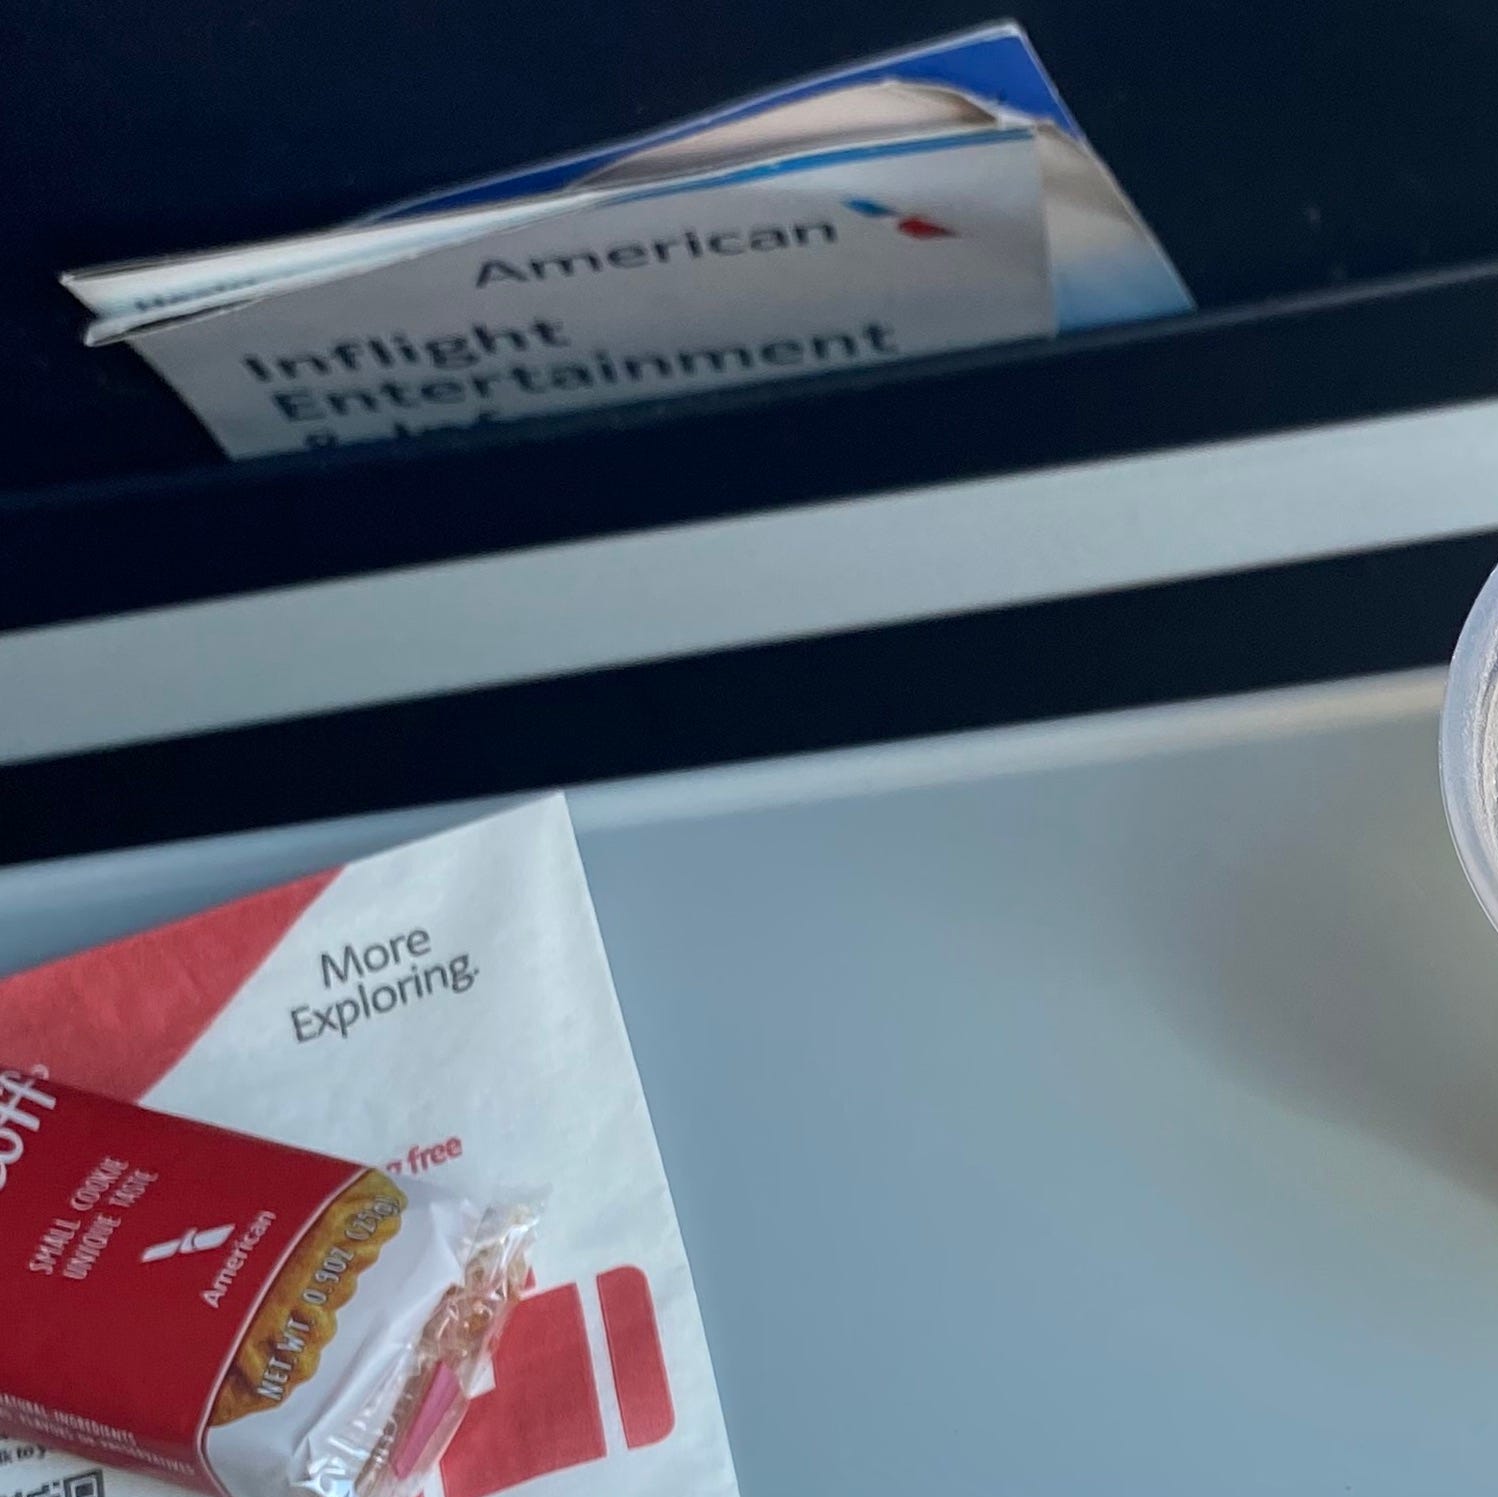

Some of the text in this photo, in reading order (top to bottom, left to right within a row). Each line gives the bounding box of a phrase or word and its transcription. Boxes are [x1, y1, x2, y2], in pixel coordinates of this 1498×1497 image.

[475, 218, 839, 289] American
[242, 318, 570, 383] Inflight
[272, 317, 895, 424] Entertainment
[290, 953, 480, 1043] Exploring.
[320, 927, 432, 989] More
[407, 1137, 463, 1175] free
[28, 1154, 130, 1276] SMALL COOKIE
[62, 1167, 159, 1281] UNIQUE TASTE
[201, 1209, 278, 1310] American
[256, 1355, 293, 1402] NET
[276, 1316, 312, 1353] WT
